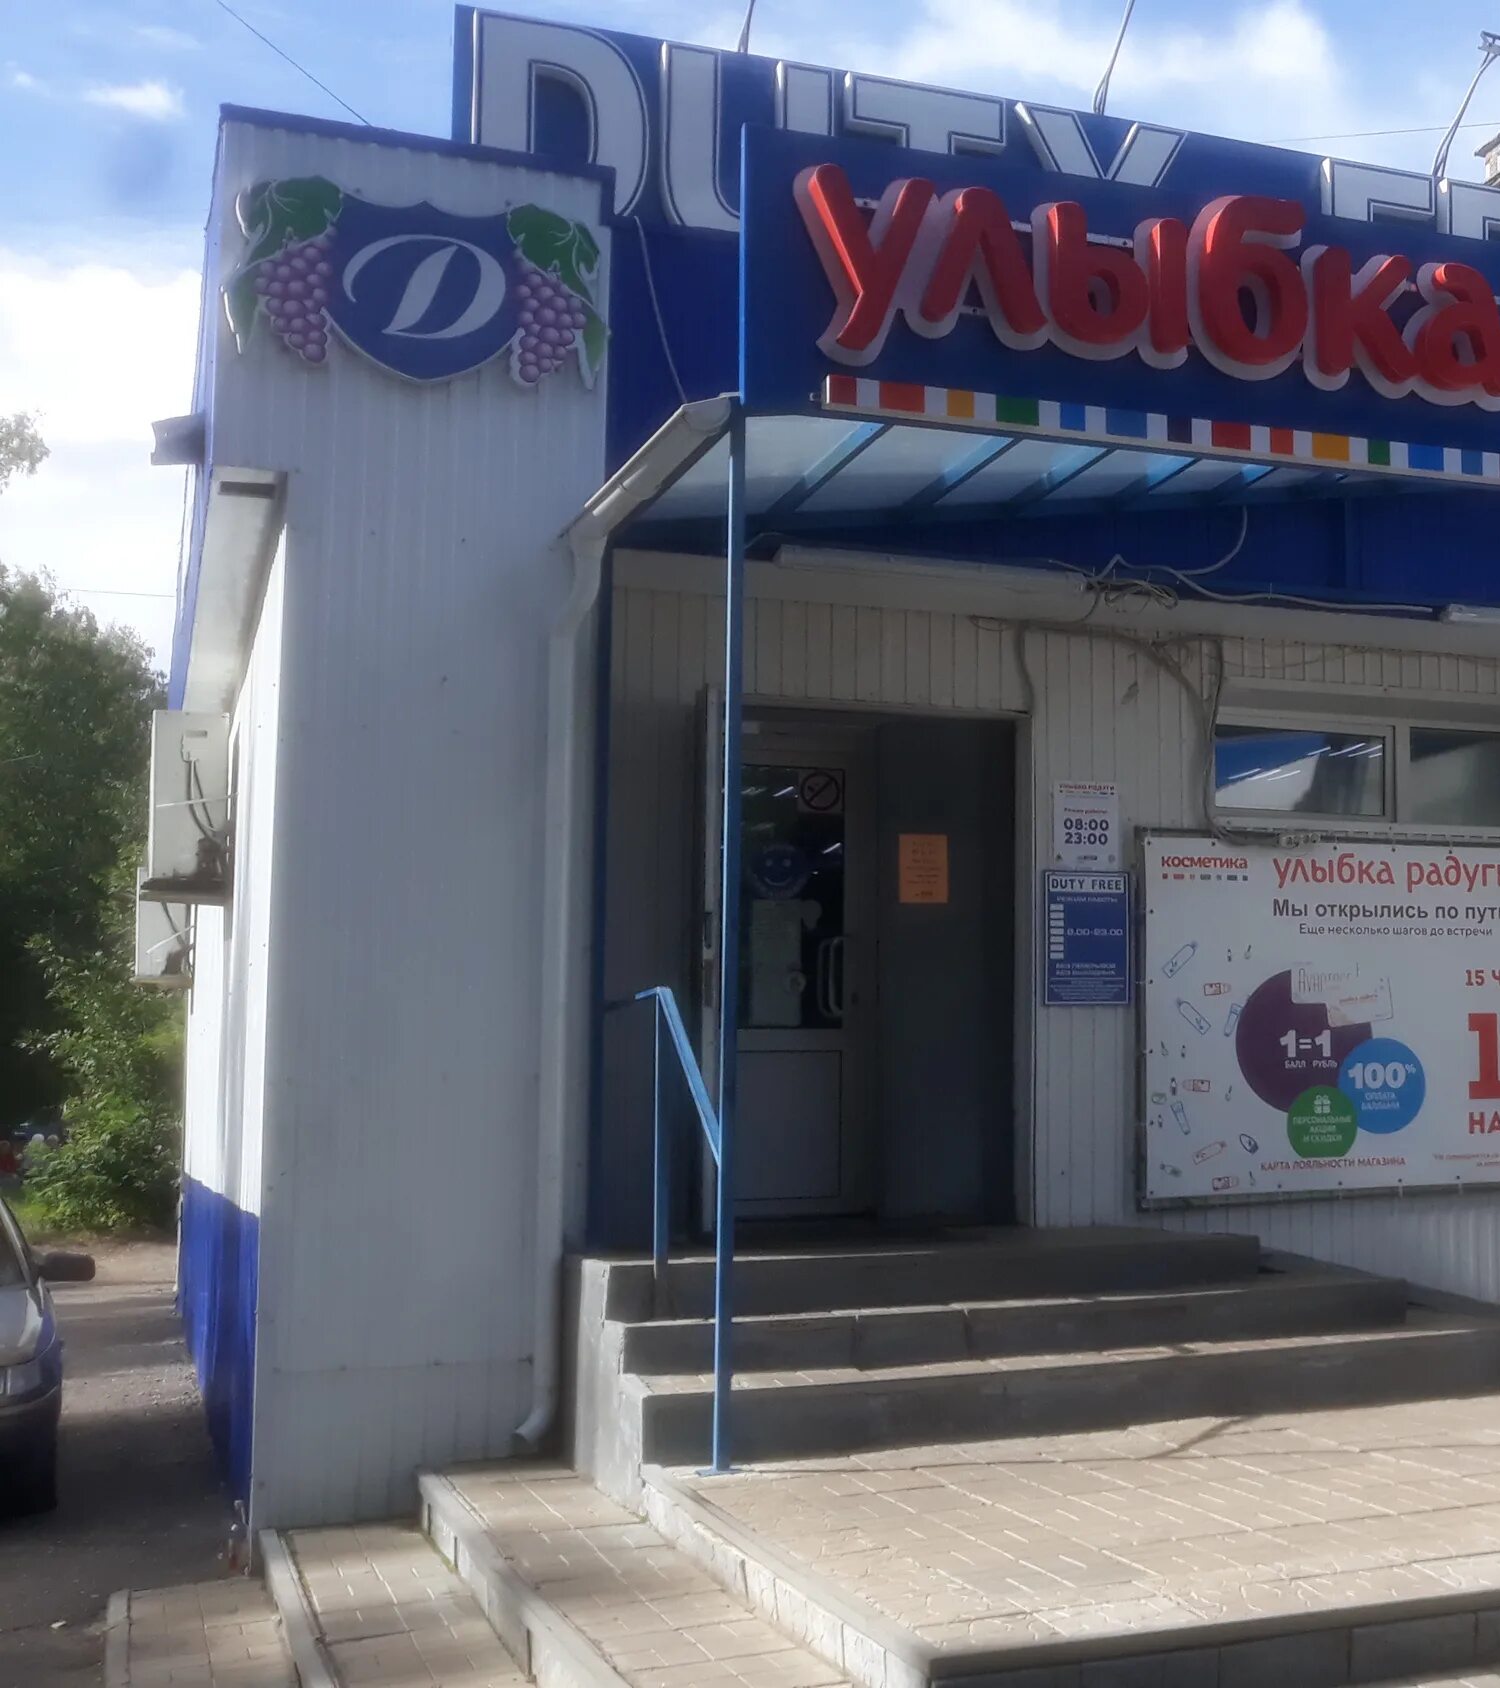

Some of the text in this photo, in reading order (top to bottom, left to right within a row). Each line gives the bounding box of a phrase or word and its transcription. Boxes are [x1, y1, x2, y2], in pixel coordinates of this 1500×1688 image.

[1063, 817, 1109, 831] 08:00
[1064, 832, 1108, 845] 23:00
[1161, 855, 1248, 870] косметика
[1272, 853, 1396, 888] улыбка
[1051, 878, 1122, 890] DUTY FREE
[1272, 898, 1308, 917] Мы
[1315, 902, 1428, 922] открылись
[1435, 904, 1459, 919] по
[1328, 925, 1390, 937] несколько
[1393, 926, 1427, 938] шагов
[1429, 927, 1445, 938] до
[1447, 926, 1493, 939] встречи
[1465, 969, 1484, 987] 15
[1348, 1062, 1417, 1089] 100%
